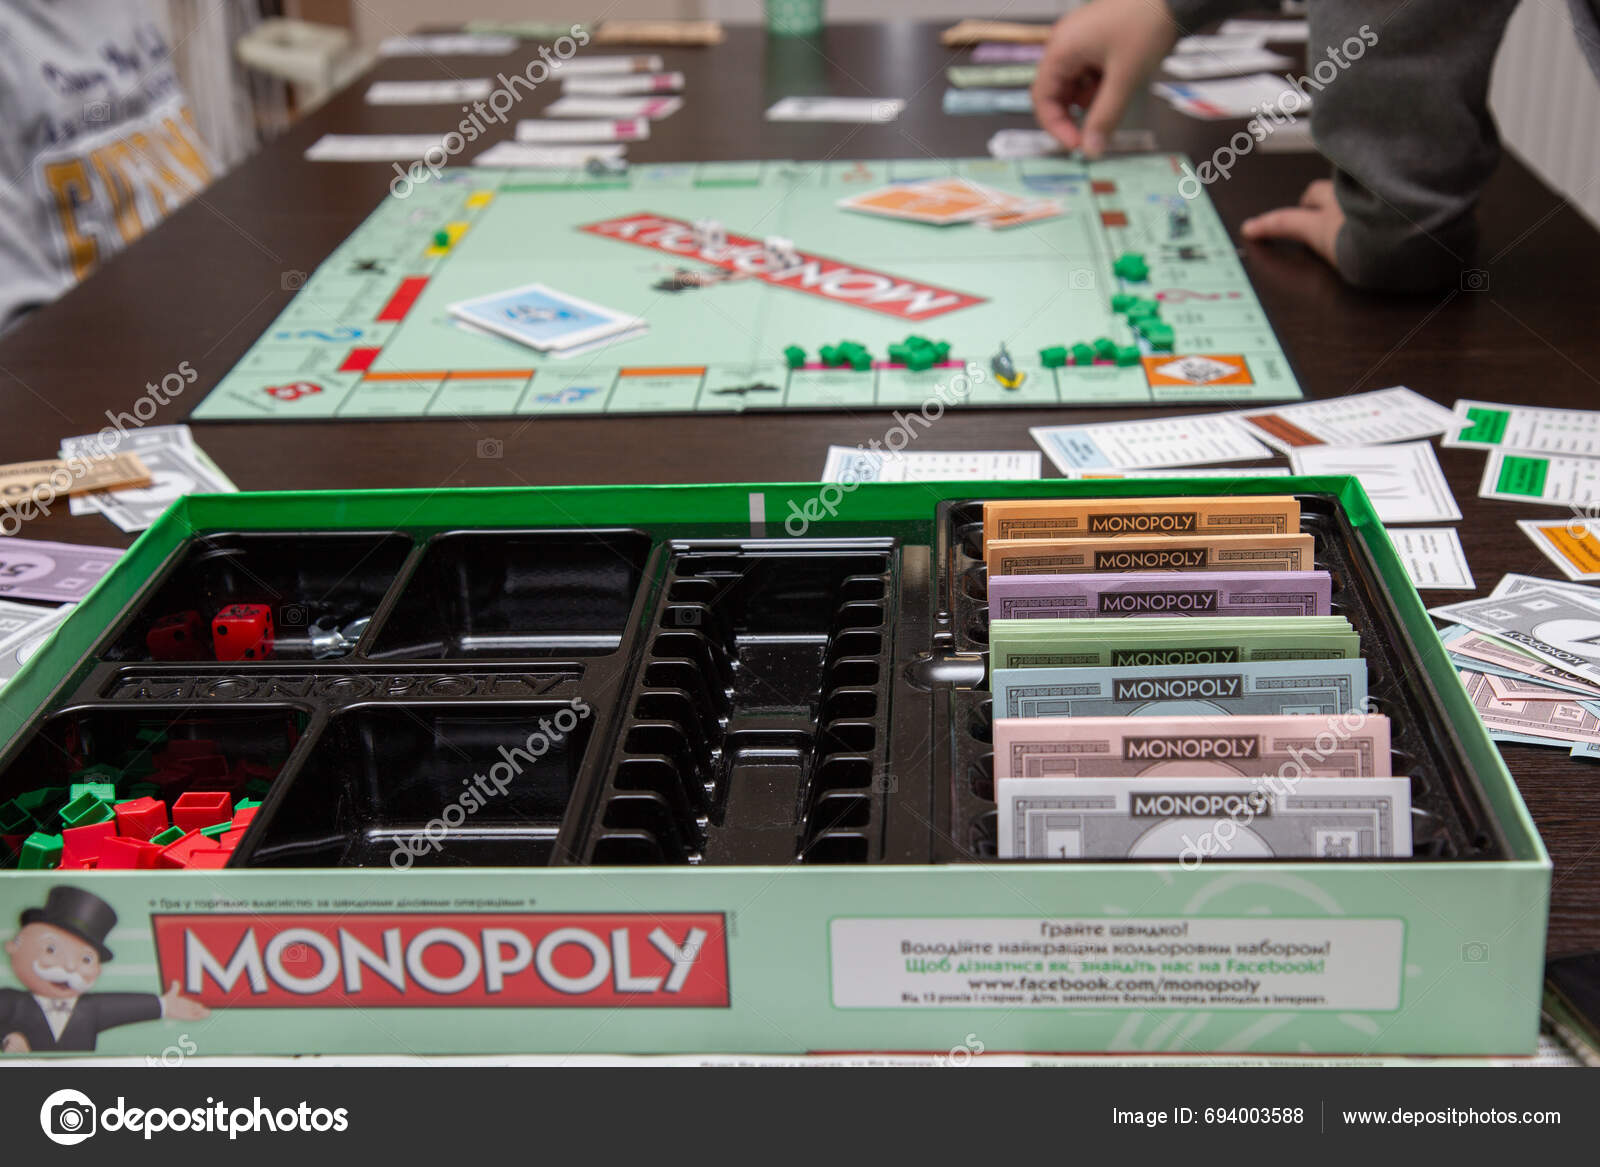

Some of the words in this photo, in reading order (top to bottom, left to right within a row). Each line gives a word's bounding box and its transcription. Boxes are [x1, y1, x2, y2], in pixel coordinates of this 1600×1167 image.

[1092, 516, 1193, 531] MONOPOLY
[1099, 552, 1204, 569] MONOPOLY
[1104, 594, 1214, 611] MONOPOLY
[1116, 650, 1235, 666] MONOPOLY
[1118, 679, 1239, 699] MONOPOLY
[1128, 739, 1256, 758] MONOPOLY
[1135, 796, 1269, 816] MONOPOLY
[1041, 921, 1104, 938] Грайте
[1110, 922, 1188, 937] швидко!
[901, 940, 993, 956] Володійте
[1113, 943, 1231, 957] кольоровим
[1236, 938, 1331, 957] набором!
[186, 927, 708, 996] MONOPOLY
[905, 957, 952, 974] Щоб
[1161, 962, 1193, 973] нас
[1199, 962, 1220, 973] на
[1226, 959, 1325, 974] Facebook!
[968, 976, 1261, 994] www.facebook.com/monopoly
